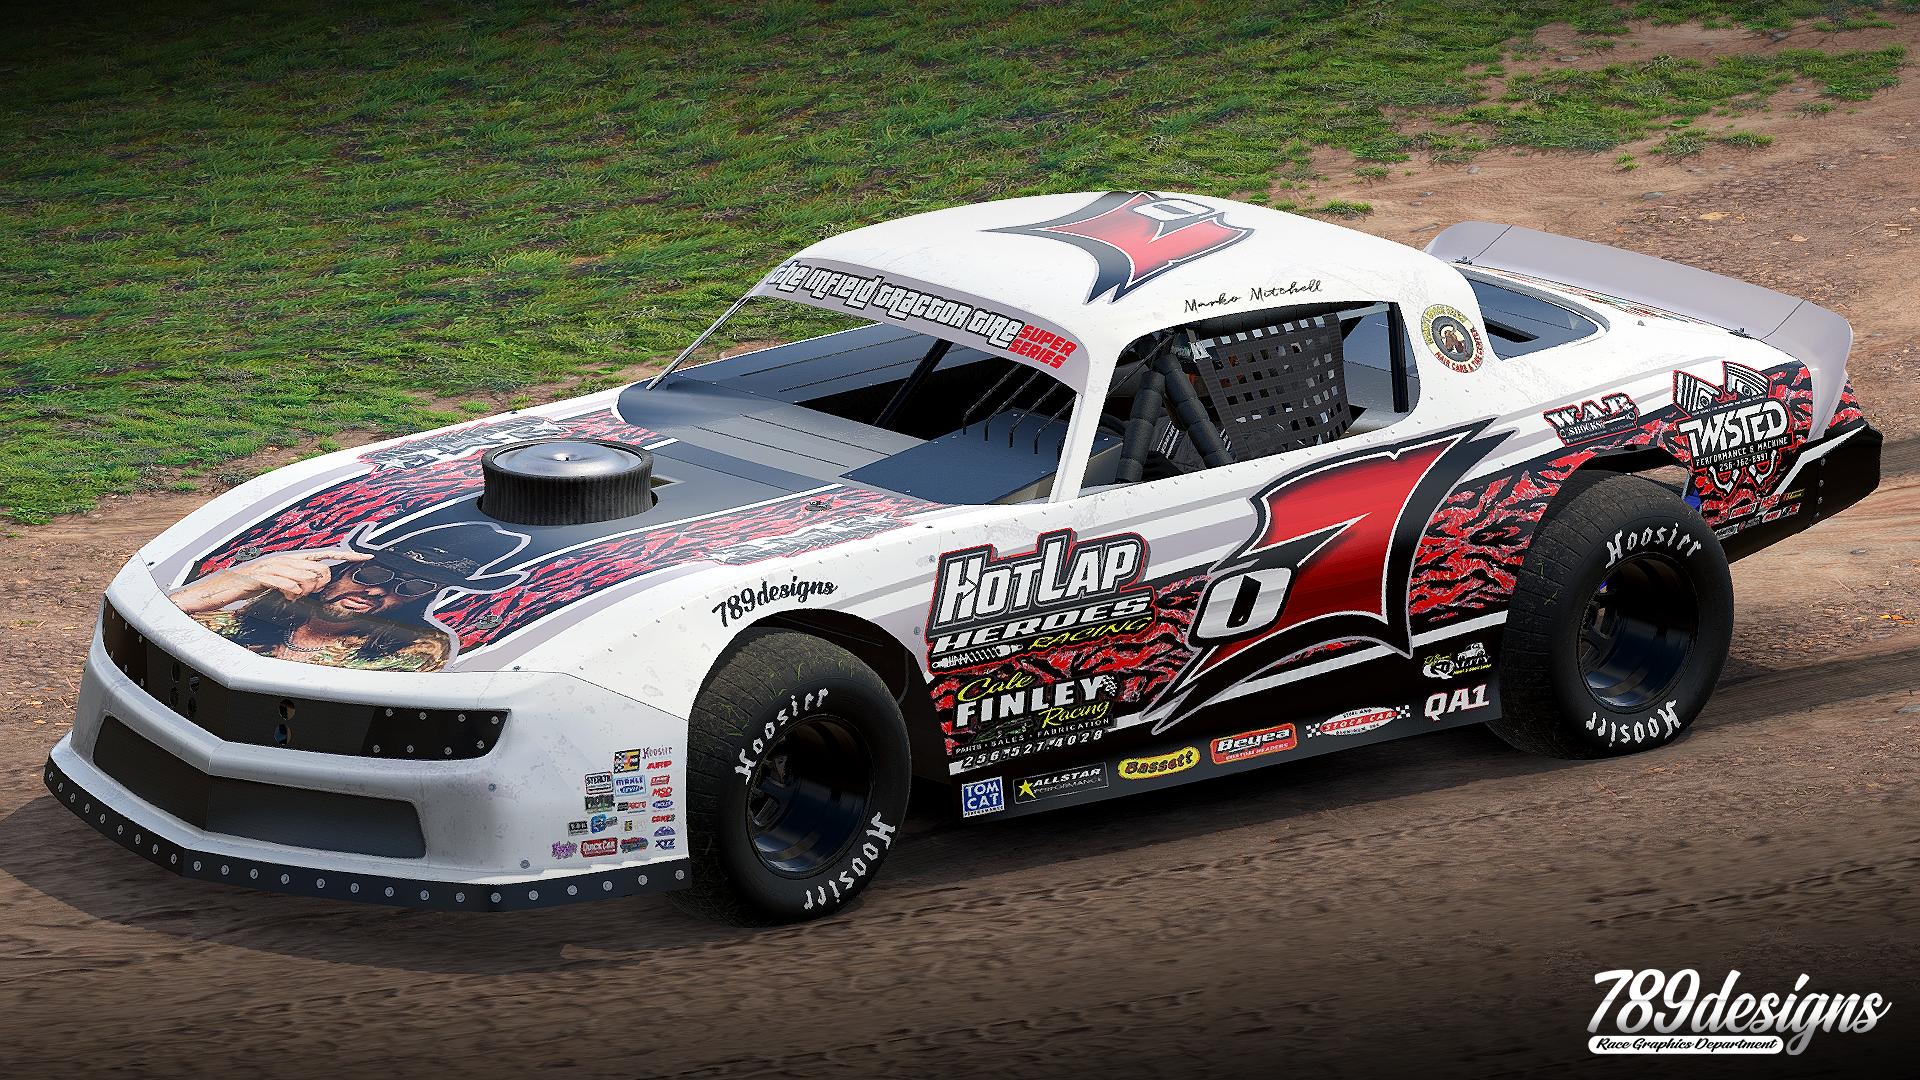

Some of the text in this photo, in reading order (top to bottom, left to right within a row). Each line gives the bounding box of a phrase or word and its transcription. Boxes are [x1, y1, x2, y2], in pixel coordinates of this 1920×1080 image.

[1184, 279, 1324, 314] Marko Mitchell
[1008, 338, 1069, 370] SERIES
[1019, 324, 1078, 356] SUPER
[1695, 447, 1747, 467] PERFORMANCE
[1757, 437, 1789, 452] MACHINE
[1605, 522, 1702, 569] Hoosier
[711, 576, 839, 628] 789designs
[933, 599, 1151, 654] HEROES
[1028, 616, 1153, 650] RACING
[956, 675, 1104, 728] FINLEY
[957, 671, 1034, 702] Cale
[1038, 700, 1110, 729] Racing
[1423, 684, 1491, 722] QA1
[734, 687, 829, 785] Hoosier
[991, 734, 1025, 748] SALES
[1037, 717, 1110, 738] FABRICATION
[1323, 711, 1394, 732] STOCK CAR
[1585, 699, 1682, 748] Hoosier
[1216, 727, 1291, 753] Beyea
[1033, 767, 1102, 787] ALLSTAR
[1124, 749, 1195, 775] Bassett
[964, 781, 1000, 797] TOM
[967, 793, 1000, 810] CAT
[803, 811, 896, 910] Hoosier
